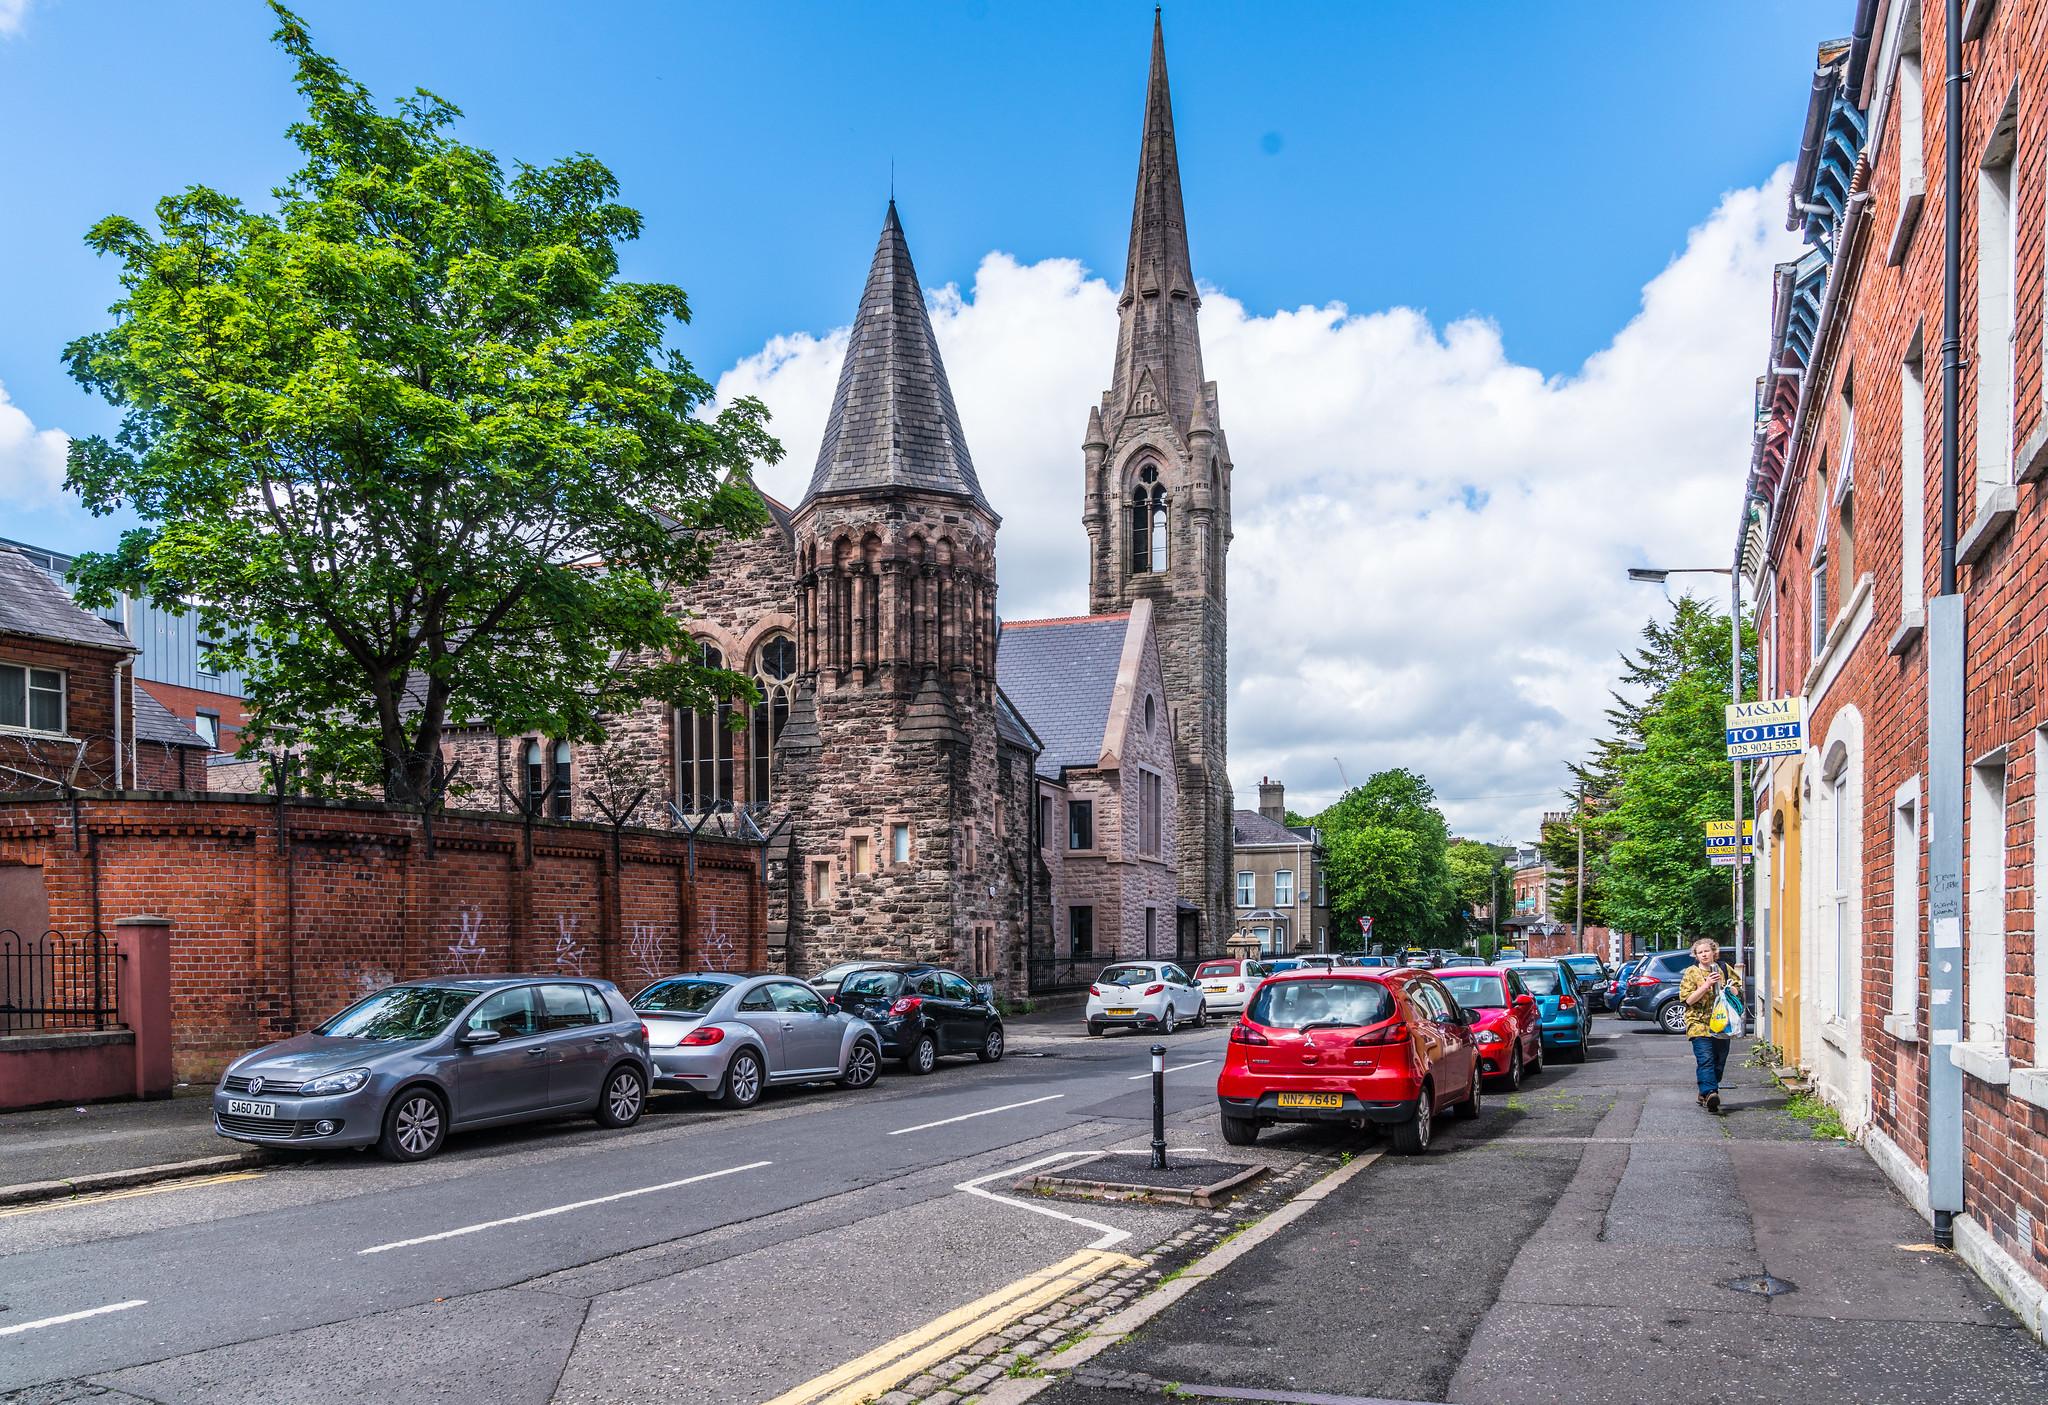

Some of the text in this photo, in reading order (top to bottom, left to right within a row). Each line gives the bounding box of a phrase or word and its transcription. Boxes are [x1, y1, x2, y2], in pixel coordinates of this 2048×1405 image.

[1735, 700, 1789, 718] M&M
[1729, 723, 1797, 743] TO LET
[1731, 739, 1798, 755] 028 9024 5555
[1708, 836, 1751, 846] TO LT
[1282, 1094, 1338, 1105] NNZ 7646
[231, 1102, 271, 1116] SA60 ZVD
